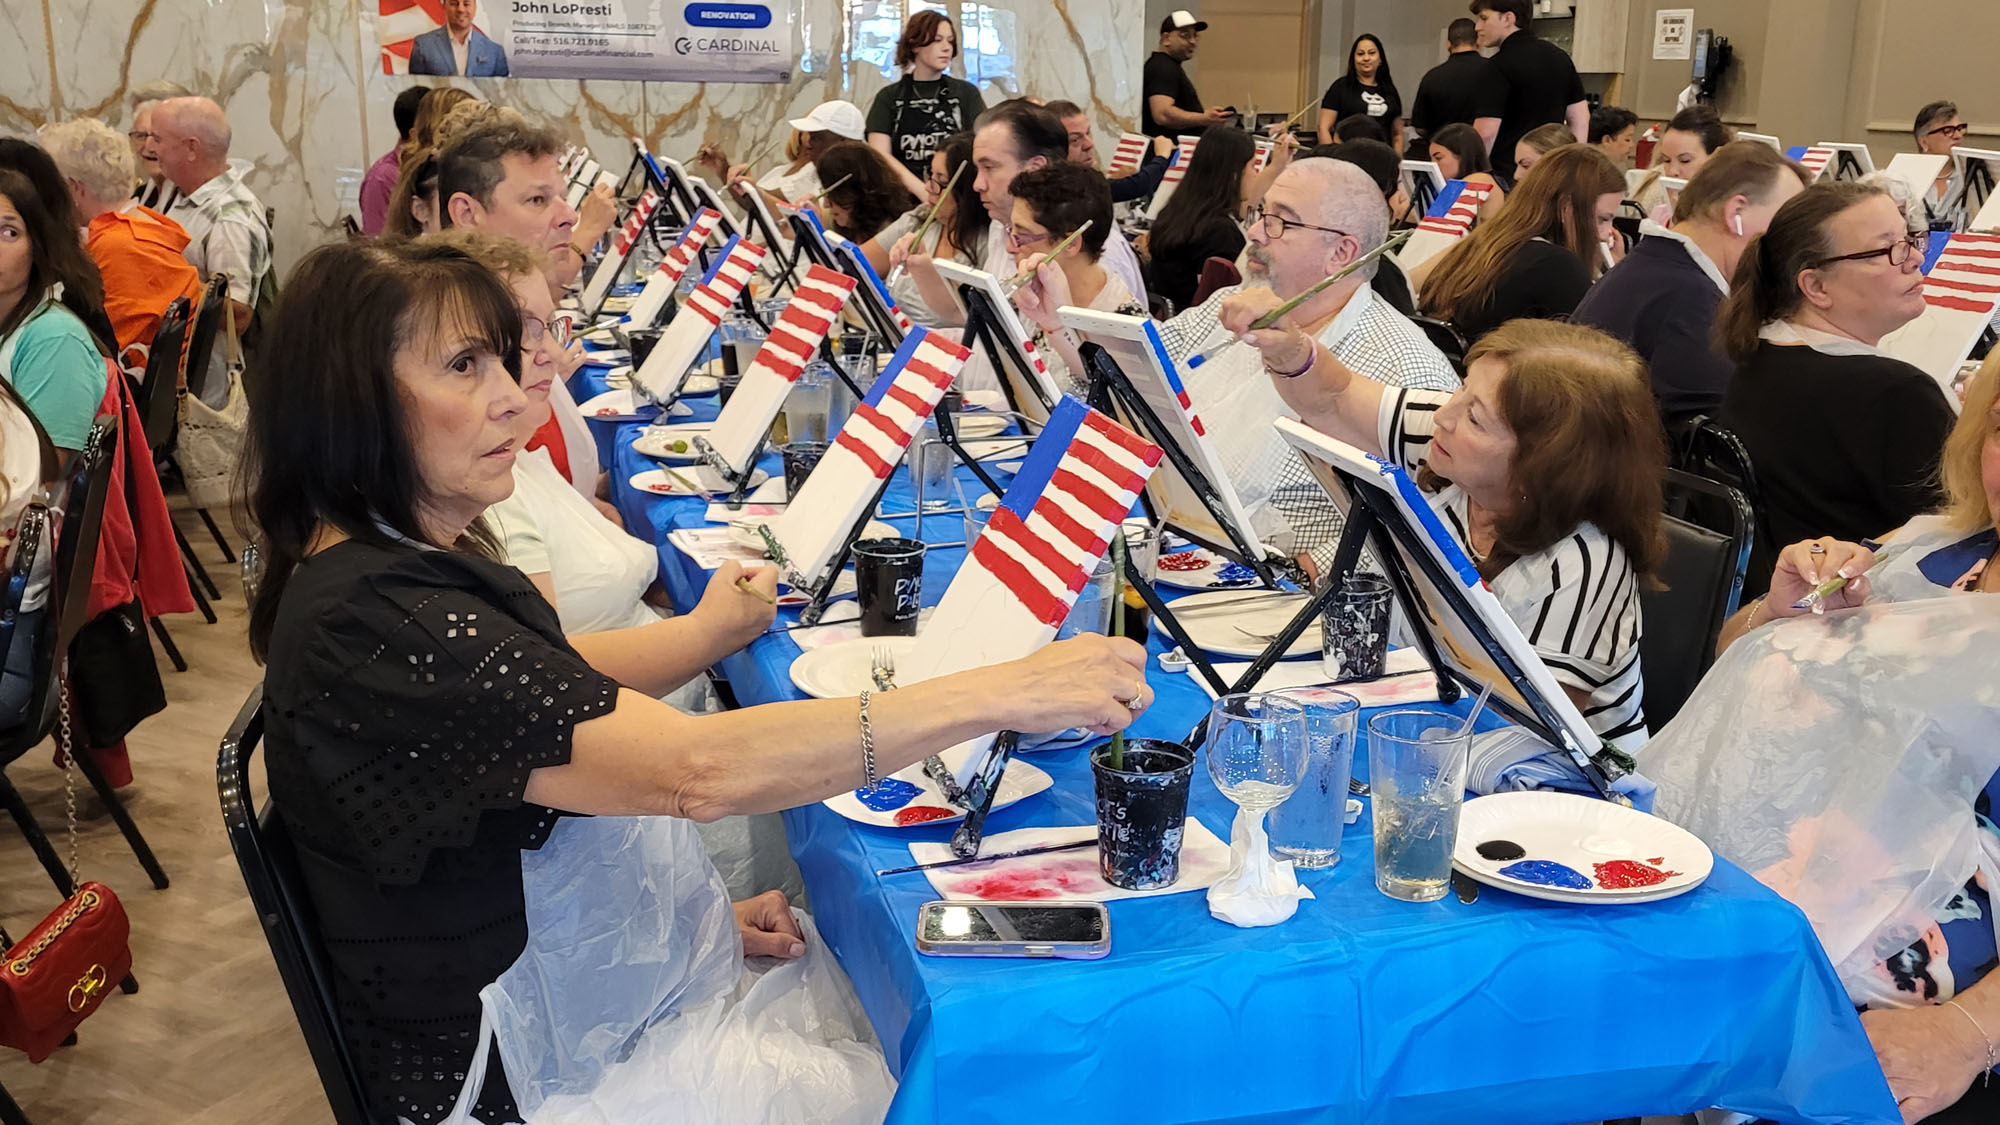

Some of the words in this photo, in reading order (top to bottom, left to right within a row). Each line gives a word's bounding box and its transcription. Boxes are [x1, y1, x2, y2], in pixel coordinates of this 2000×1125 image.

[511, 1, 549, 13] John
[552, 3, 612, 16] LoPresti
[700, 11, 756, 20] RENOVATION
[696, 38, 780, 53] CARDINAL
